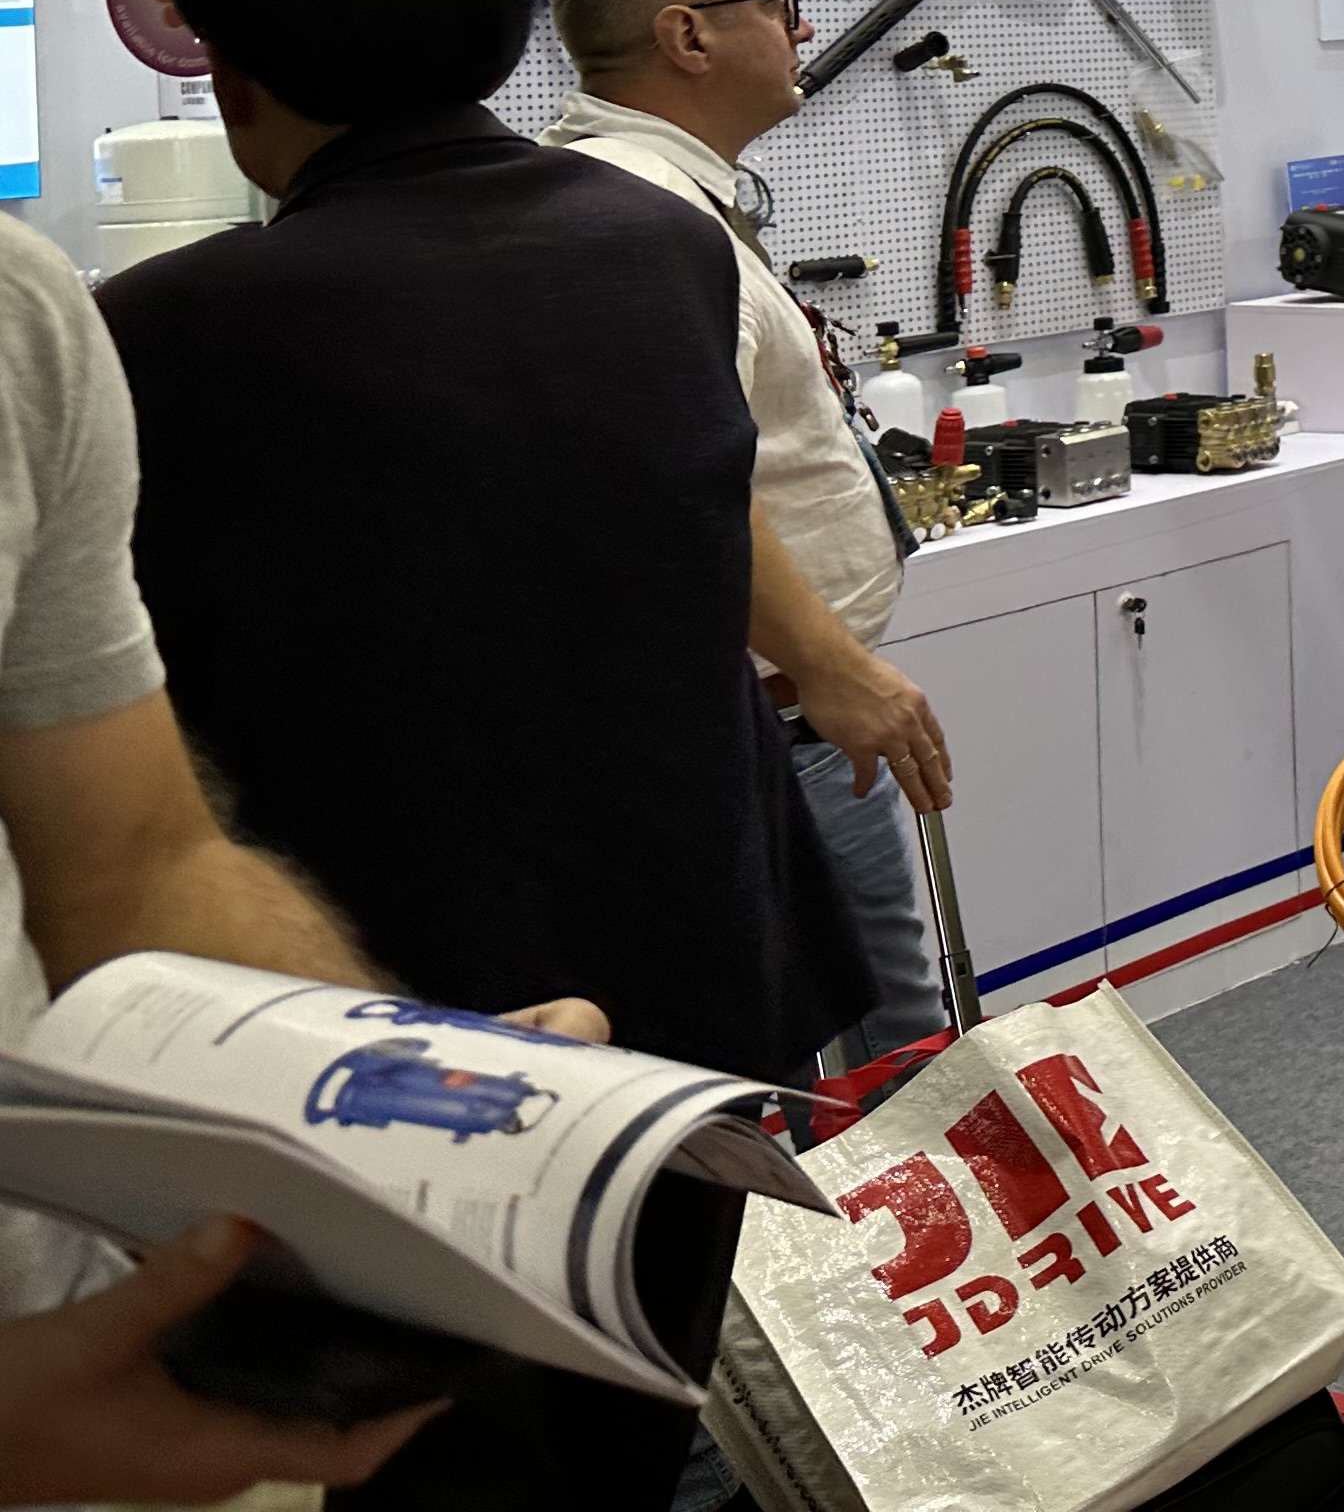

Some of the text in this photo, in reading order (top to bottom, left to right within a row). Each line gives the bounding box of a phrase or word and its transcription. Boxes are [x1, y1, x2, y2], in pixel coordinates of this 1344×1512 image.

[835, 1053, 1150, 1301] JIE
[952, 1234, 1240, 1416] 杰牌智能传动方案提供商
[968, 1260, 1248, 1432] JIE INTELLIGENT DRIVE SOLUTIONS PROVIDER
